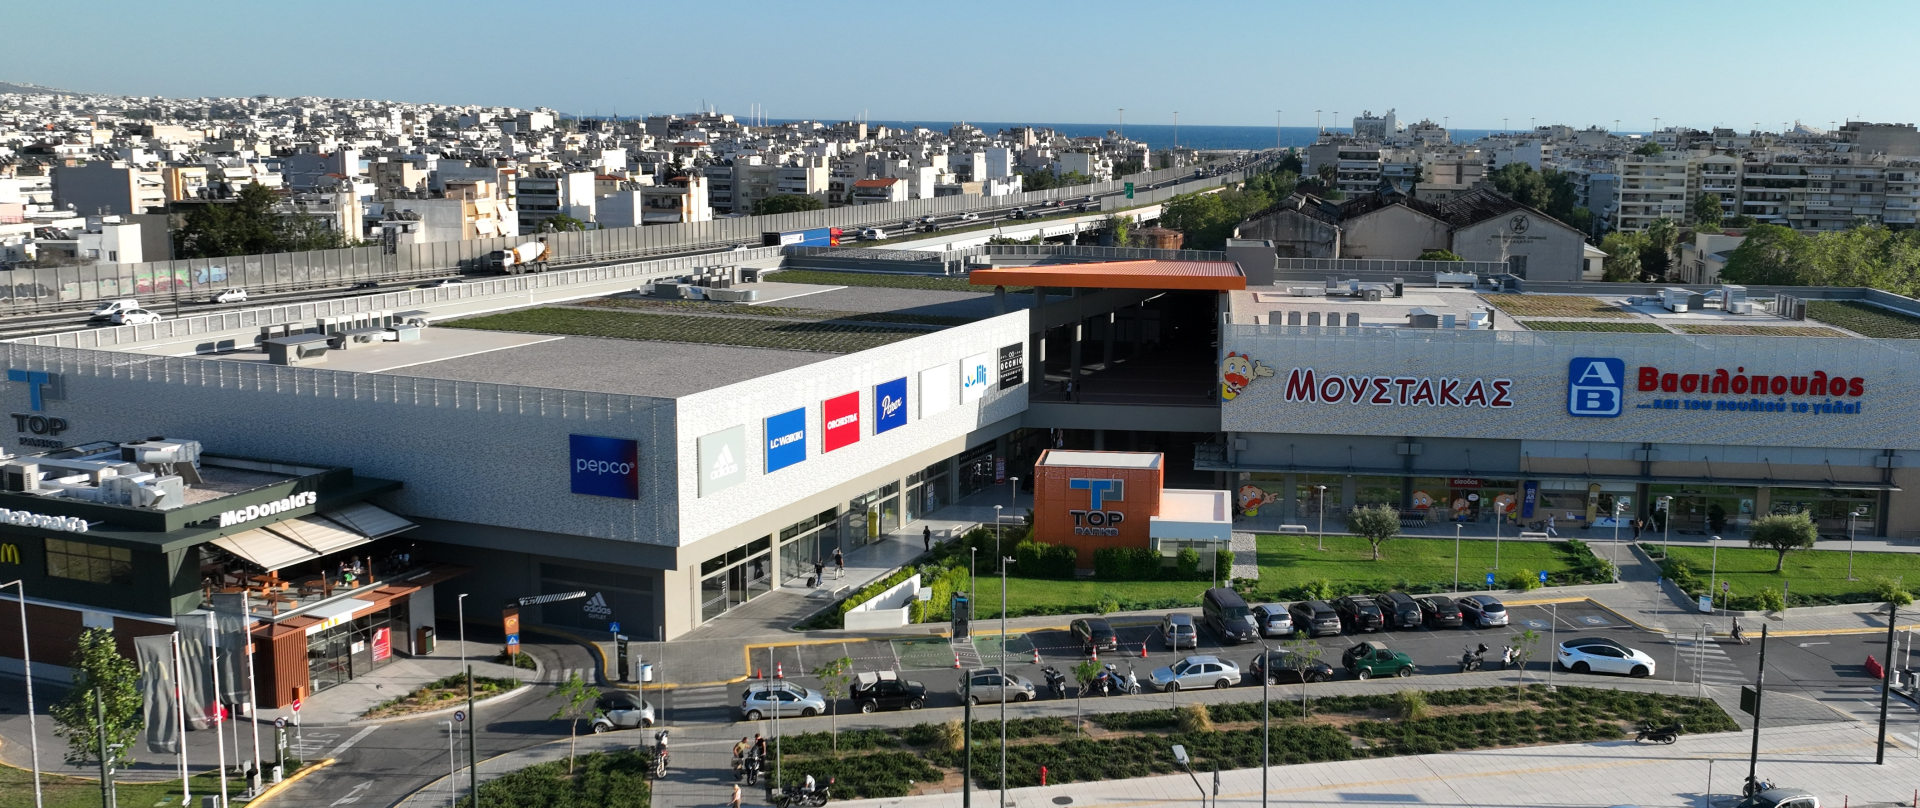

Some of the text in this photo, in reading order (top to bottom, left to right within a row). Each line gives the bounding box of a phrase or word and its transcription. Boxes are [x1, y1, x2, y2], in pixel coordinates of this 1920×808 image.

[1000, 356, 1023, 371] OCCHIO
[1638, 366, 1865, 397] Βασιλόπουλος
[1684, 399, 1712, 411] του
[1716, 397, 1787, 412] πουλιού
[1791, 401, 1809, 412] το
[1813, 398, 1861, 415] γάλα!
[11, 412, 67, 436] TOP
[827, 413, 858, 430] ORCHESTRA
[19, 436, 62, 449] PARKS
[770, 438, 779, 450] LC
[710, 463, 738, 480] adidas
[220, 491, 317, 528] McDonald's
[1070, 509, 1124, 527] TOP
[1075, 526, 1119, 536] PARKS
[583, 604, 611, 615] adidas
